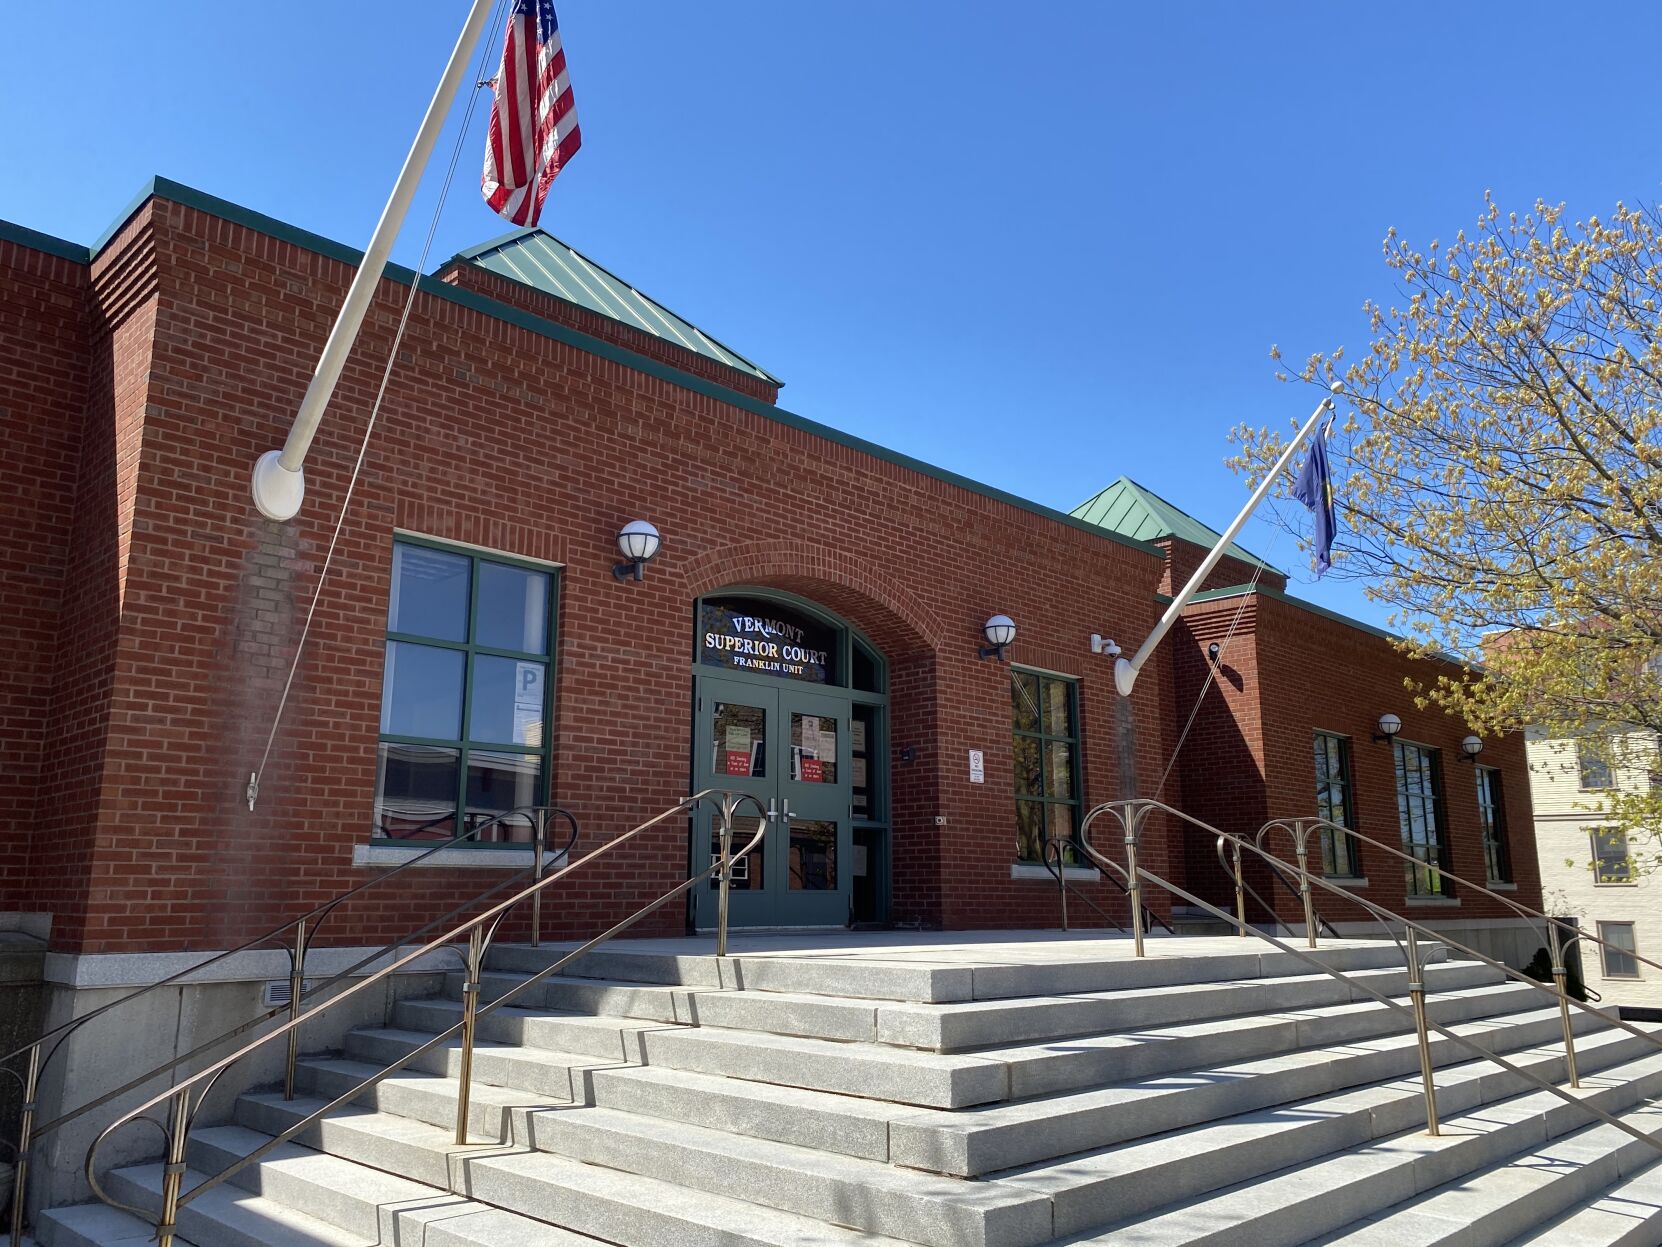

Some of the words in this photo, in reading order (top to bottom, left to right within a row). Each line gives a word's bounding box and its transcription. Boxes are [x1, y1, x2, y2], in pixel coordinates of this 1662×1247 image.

[733, 617, 804, 643] VERMONT
[705, 633, 778, 658] SUPERIOR
[782, 645, 827, 665] COURT
[733, 656, 780, 671] FRANKLIN
[782, 663, 804, 675] UNIT
[523, 670, 537, 691] P
